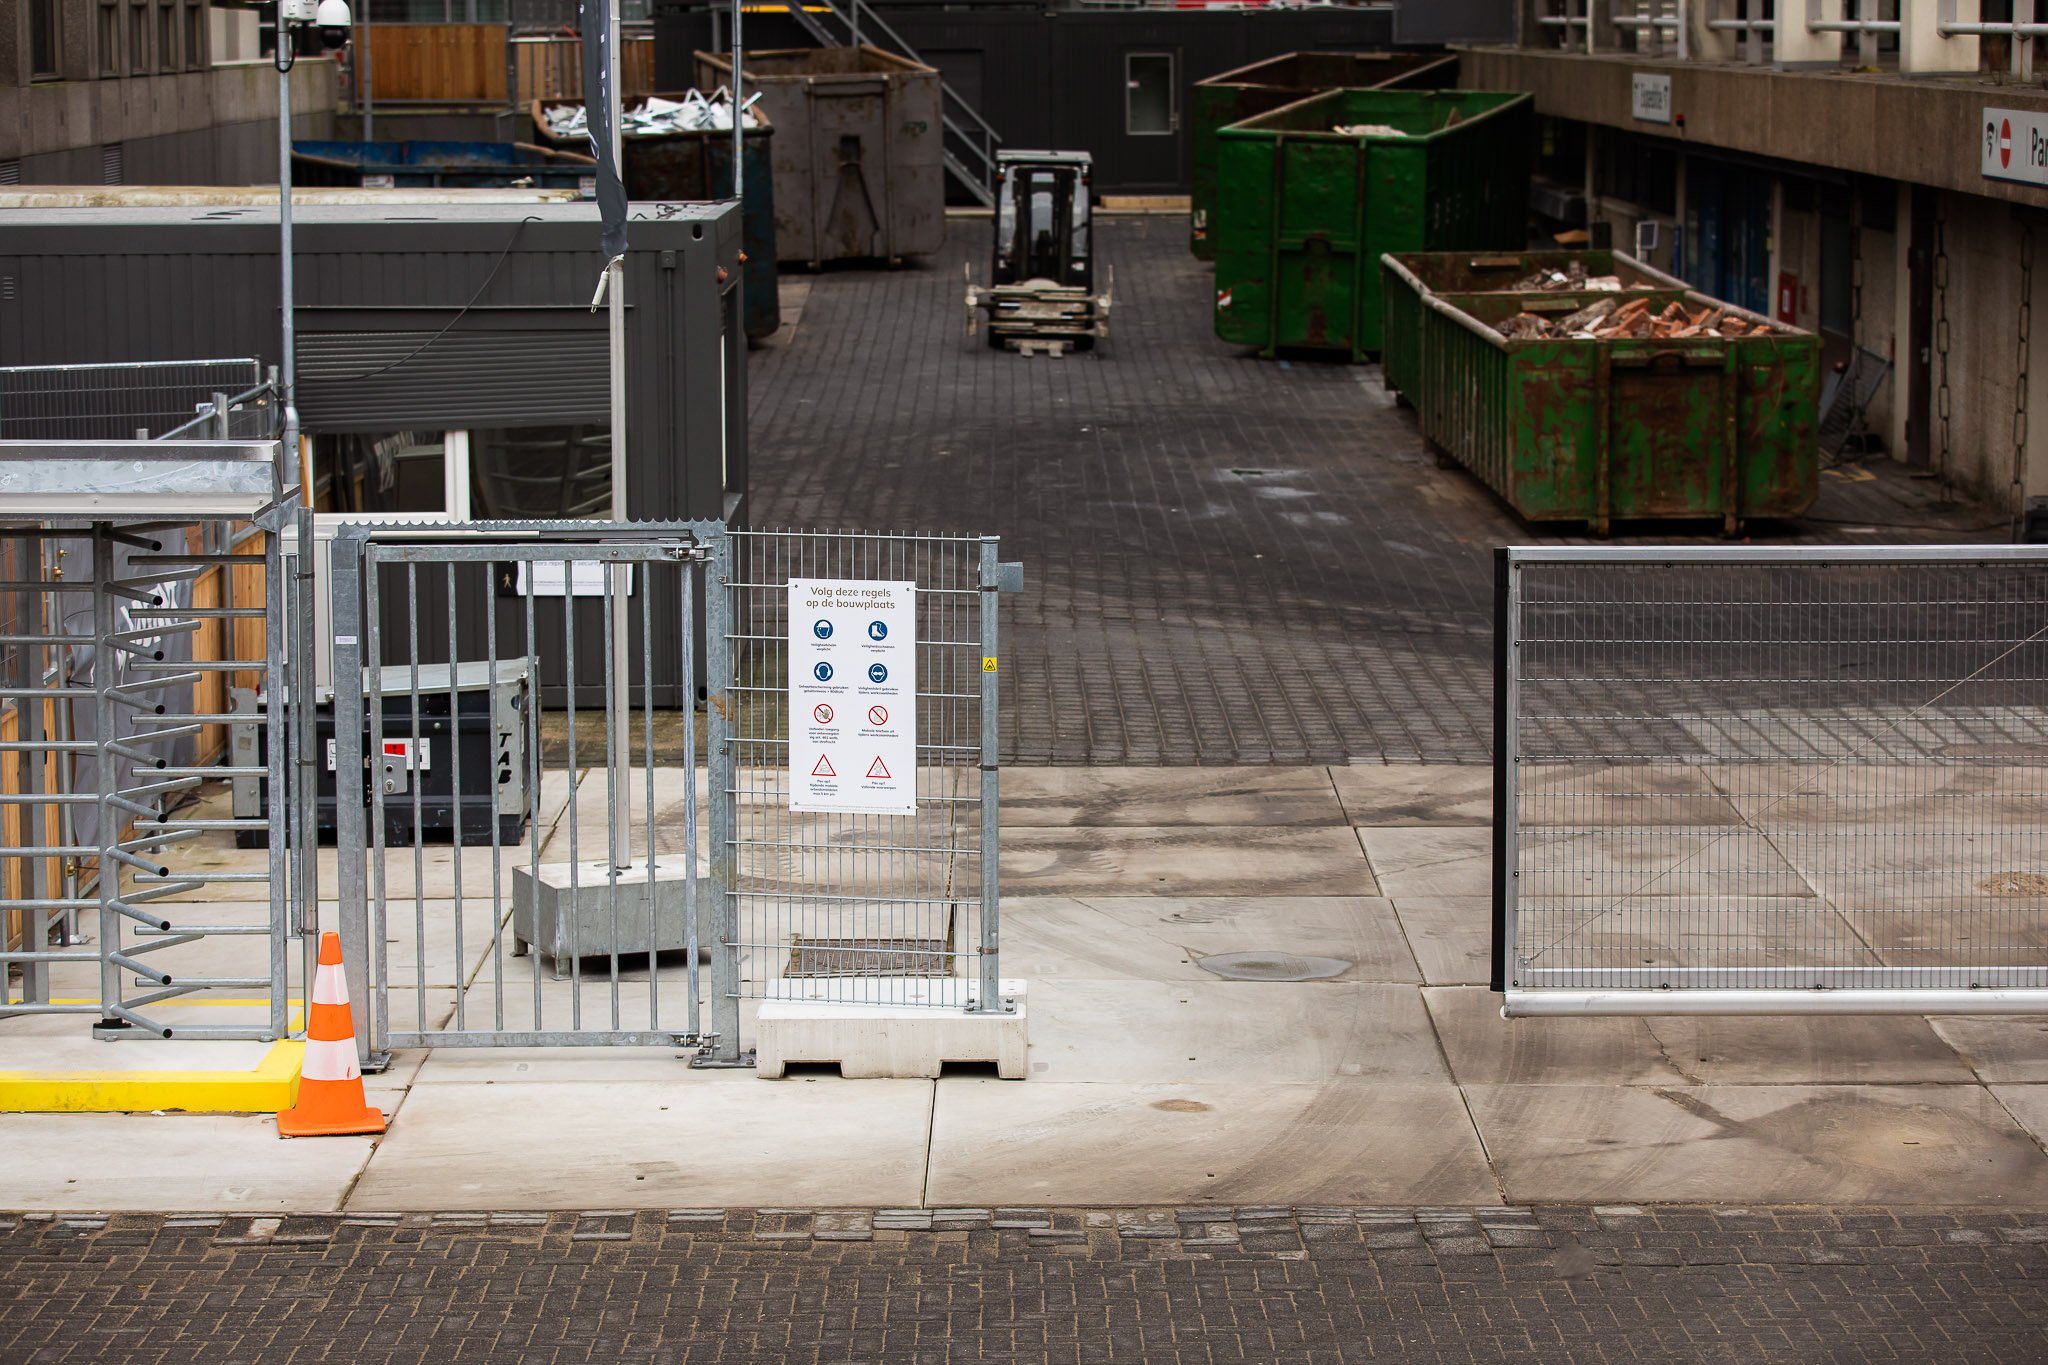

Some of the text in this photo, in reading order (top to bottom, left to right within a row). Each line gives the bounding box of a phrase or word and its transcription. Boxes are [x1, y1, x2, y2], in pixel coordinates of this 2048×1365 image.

[810, 587, 891, 599] Volg deze regels
[806, 599, 895, 610] op de bouwplaats
